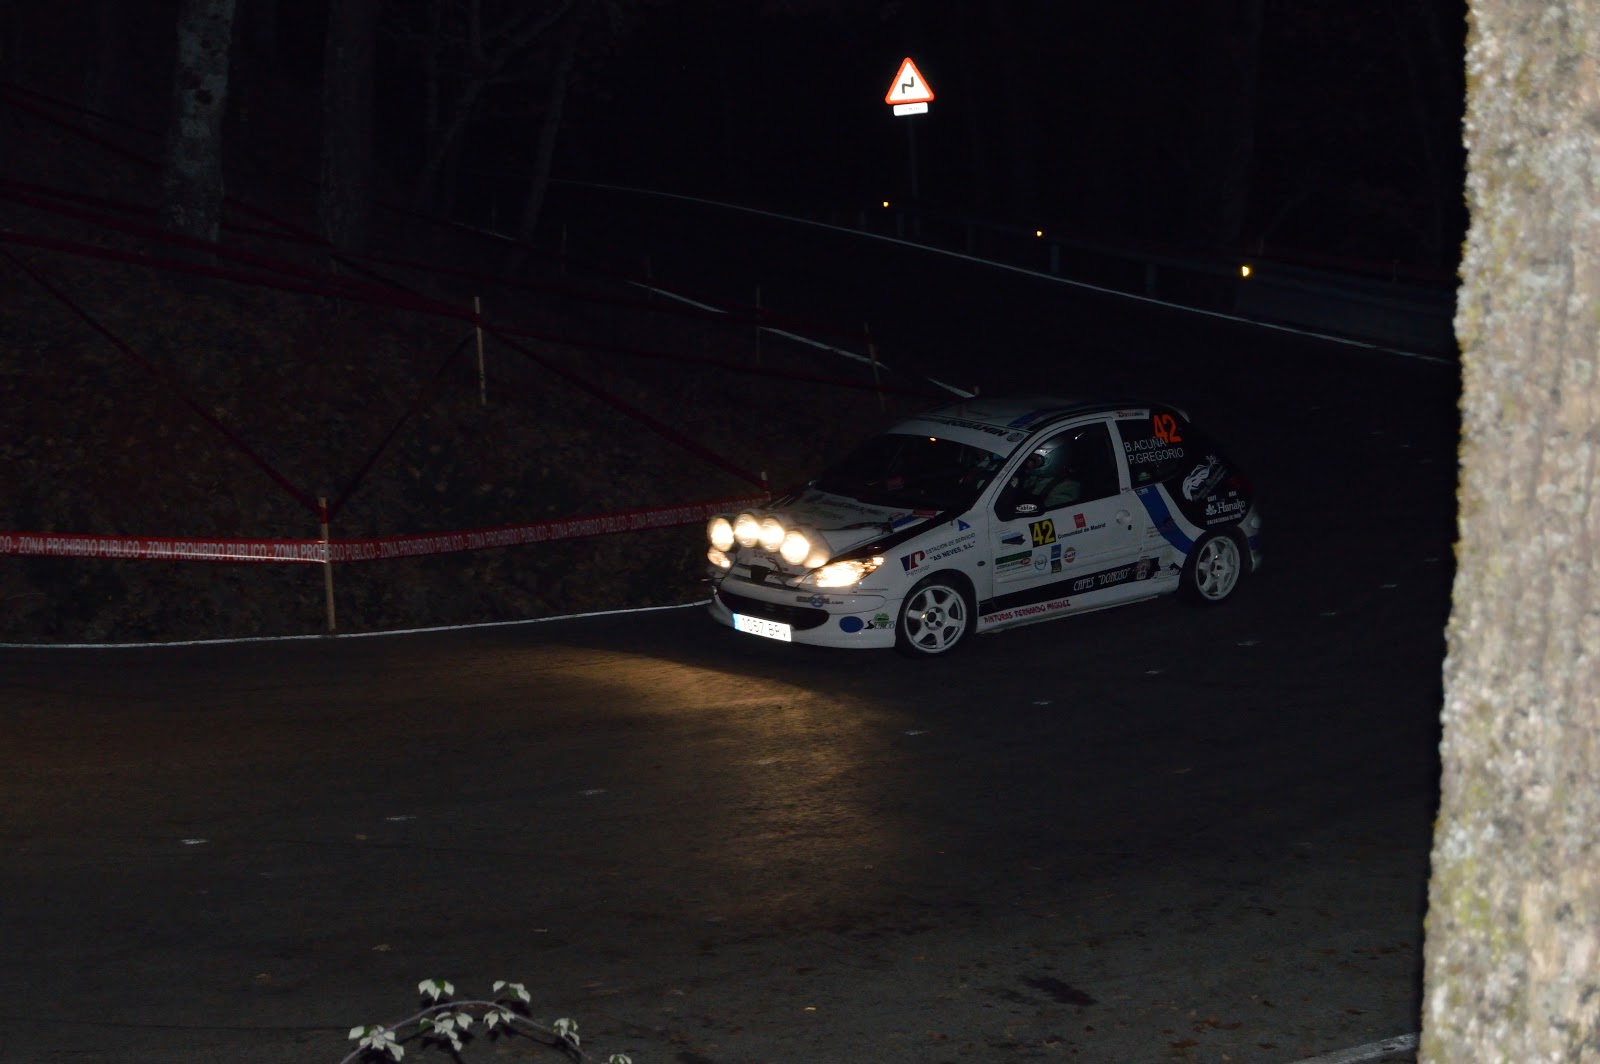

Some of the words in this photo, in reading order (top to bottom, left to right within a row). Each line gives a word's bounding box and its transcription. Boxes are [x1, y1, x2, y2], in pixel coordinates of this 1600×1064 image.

[1153, 413, 1182, 443] 42
[1128, 447, 1184, 464] P.GREGORIO
[1217, 499, 1246, 514] Hanako
[1032, 520, 1056, 545] 42
[1058, 529, 1083, 539] Comunidad
[1090, 523, 1106, 531] Madrid
[19, 537, 44, 555] ZONA
[46, 538, 97, 557] PROHIBIDO
[100, 539, 140, 558] PUBLICO
[146, 541, 171, 559] ZONA
[174, 542, 224, 560] PROHIBIDO
[226, 543, 267, 561] PUBLICO
[274, 544, 298, 561] ZONA
[345, 543, 375, 560] PUBLICO
[380, 541, 399, 558] ZONA
[399, 537, 435, 557] PROHIBIDO
[435, 535, 463, 552] PUBLICO
[467, 532, 486, 549] ZONA
[1064, 551, 1076, 559] Gulf
[1014, 604, 1046, 617] FERNANDO
